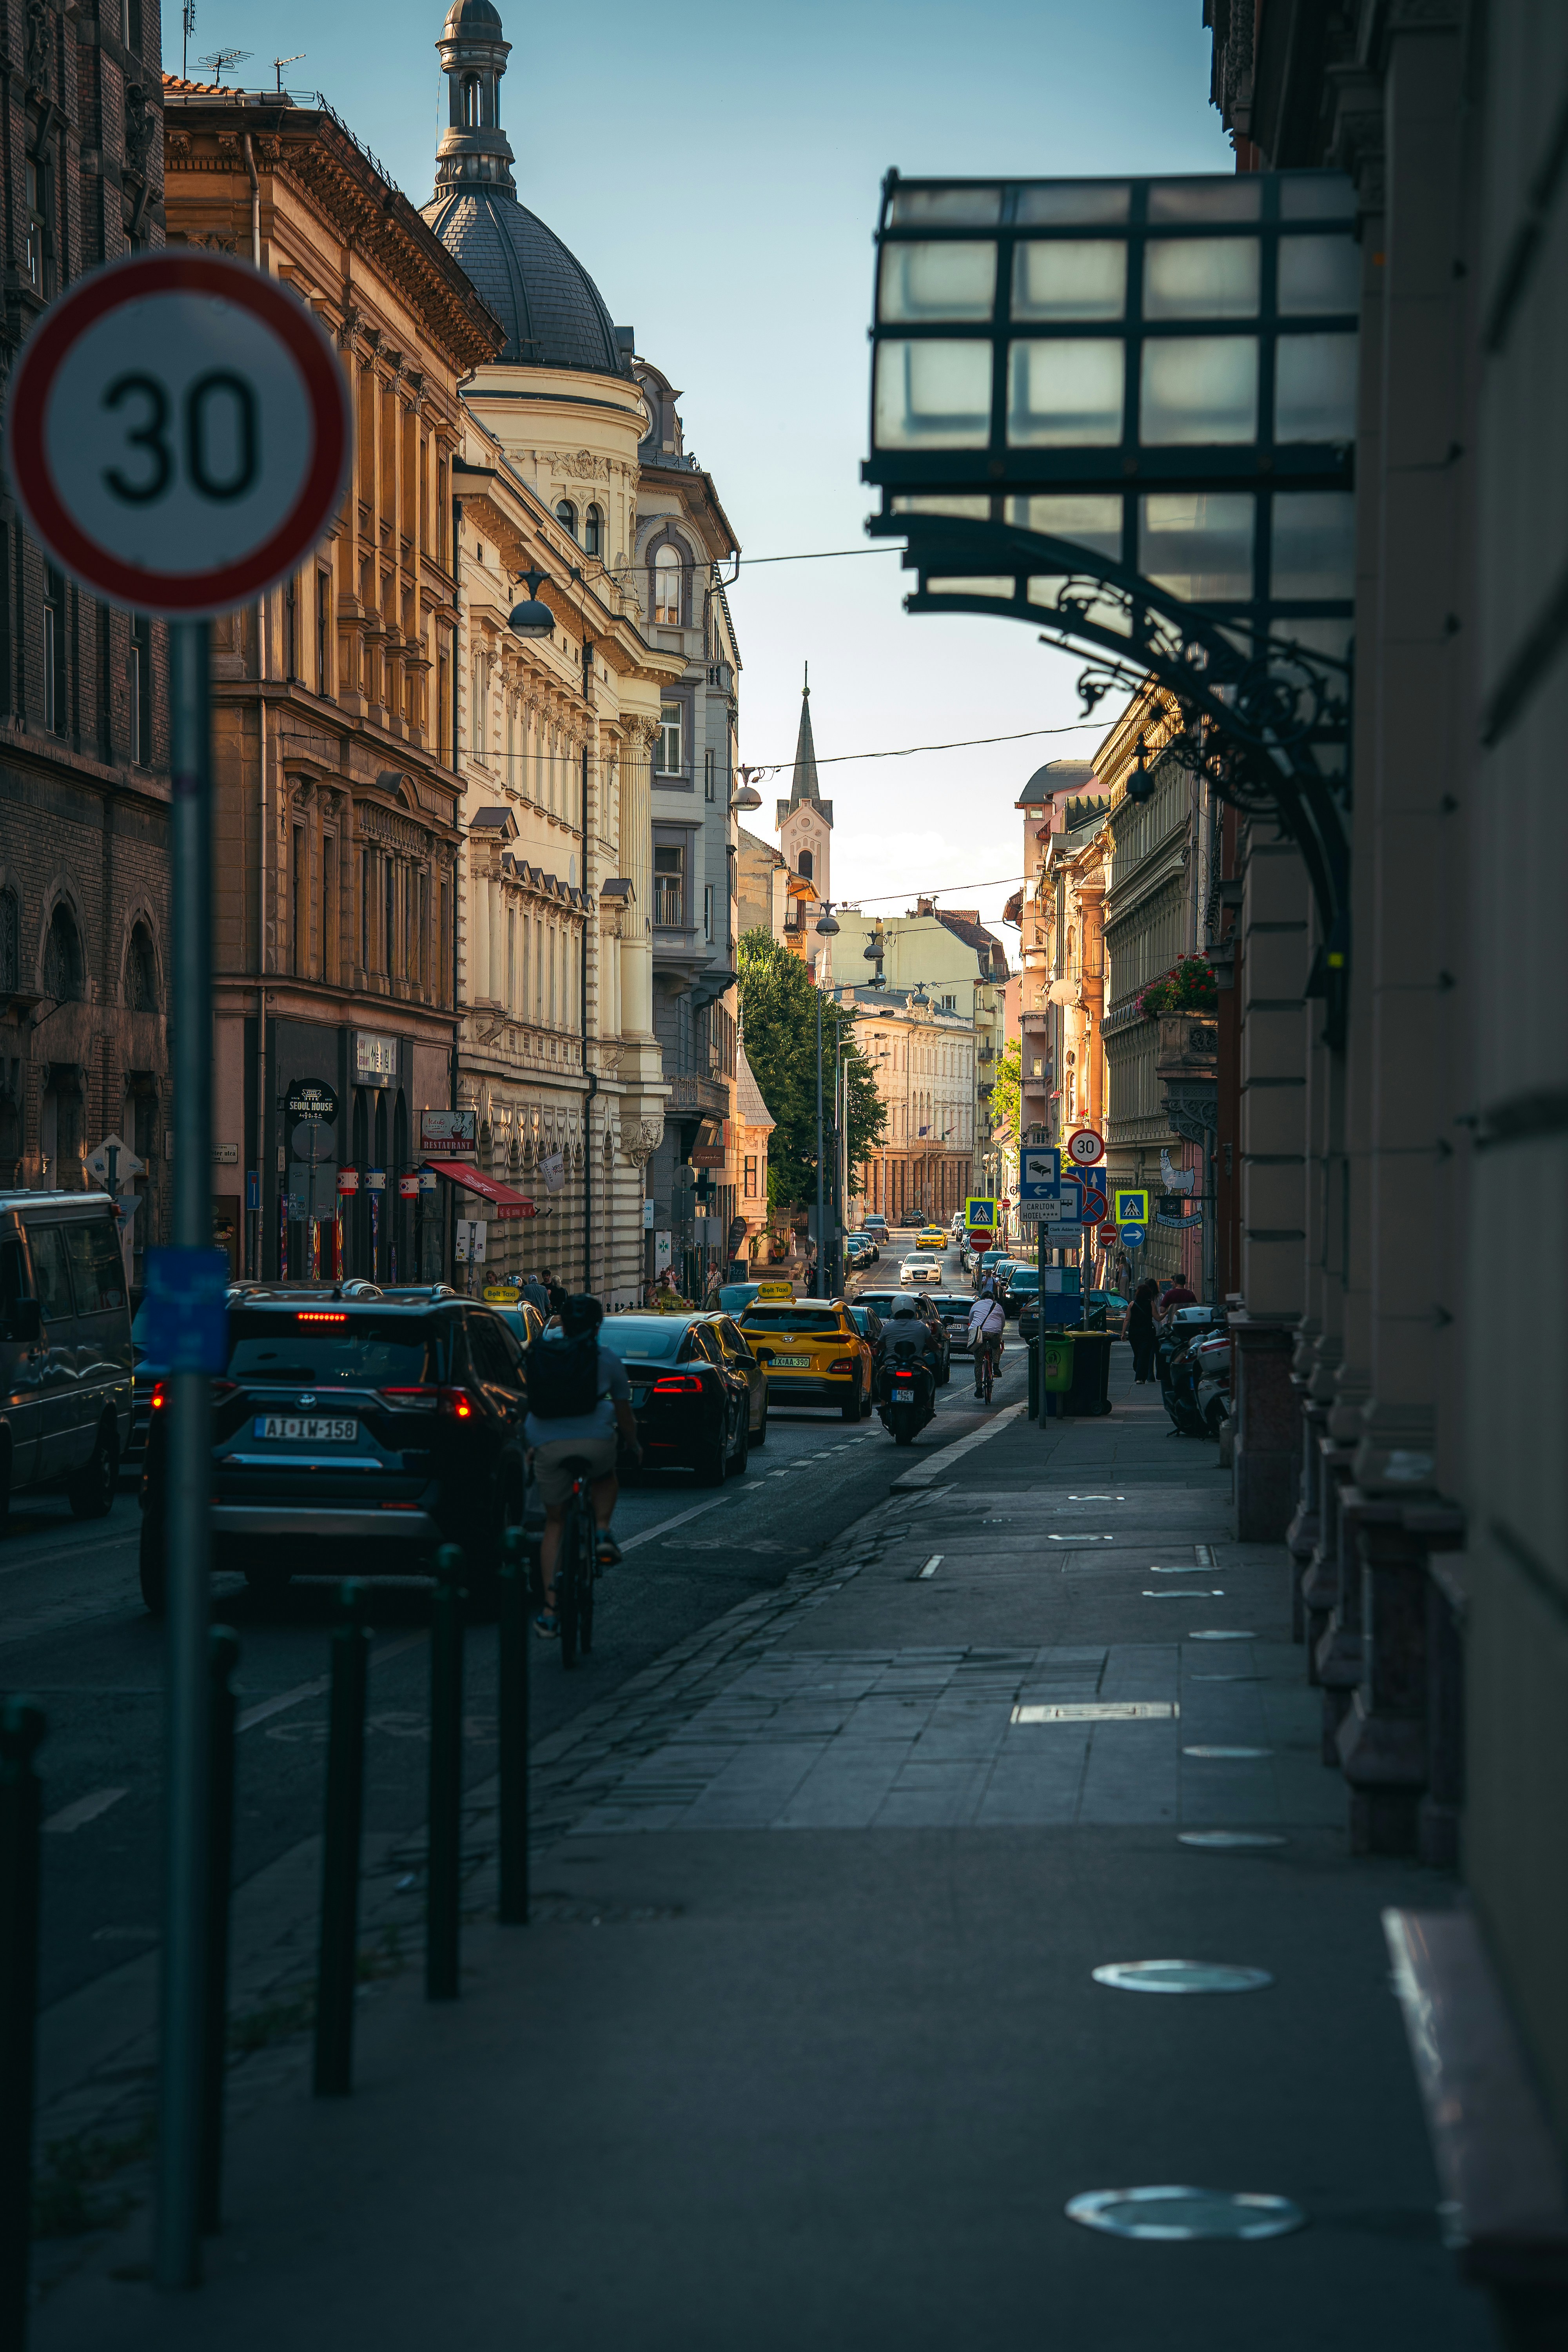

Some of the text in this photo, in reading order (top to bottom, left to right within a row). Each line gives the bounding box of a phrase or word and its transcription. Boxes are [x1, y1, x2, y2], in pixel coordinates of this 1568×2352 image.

[103, 372, 258, 506] 30
[290, 1102, 333, 1111] SEOUL HOUSE
[1077, 1140, 1094, 1154] 30
[544, 1163, 554, 1182] CSÁSZÁR
[1186, 1214, 1200, 1225] bagel
[267, 1420, 354, 1438] AI IW-158
